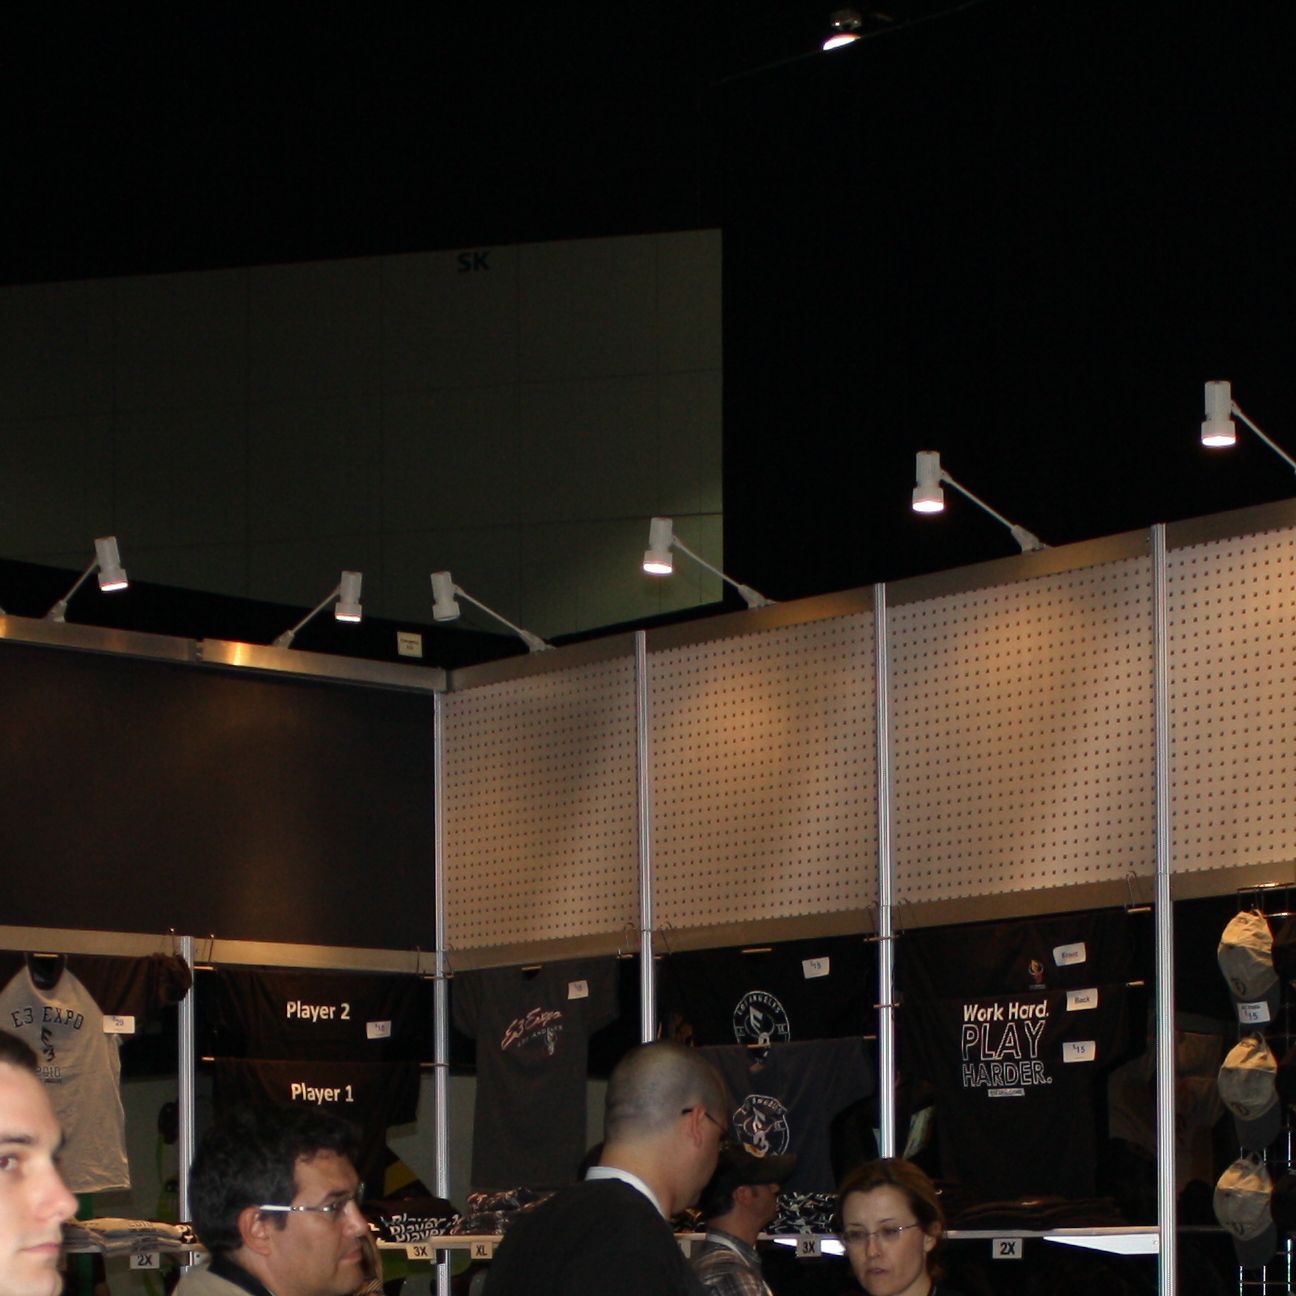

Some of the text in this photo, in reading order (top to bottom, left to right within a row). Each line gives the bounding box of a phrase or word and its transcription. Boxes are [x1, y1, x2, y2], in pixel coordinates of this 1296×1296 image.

[457, 251, 491, 273] SK
[11, 1006, 85, 1030] E3 EXPO
[286, 1000, 351, 1023] Player 2
[962, 1000, 1050, 1022] Work Hard.
[961, 1020, 1046, 1062] PLAY
[962, 1060, 1053, 1088] HARDER.
[290, 1082, 355, 1106] Player 1
[413, 1246, 429, 1257] 3X
[475, 1245, 488, 1256] XL
[999, 1242, 1016, 1255] 2X
[137, 1254, 153, 1266] 2X
